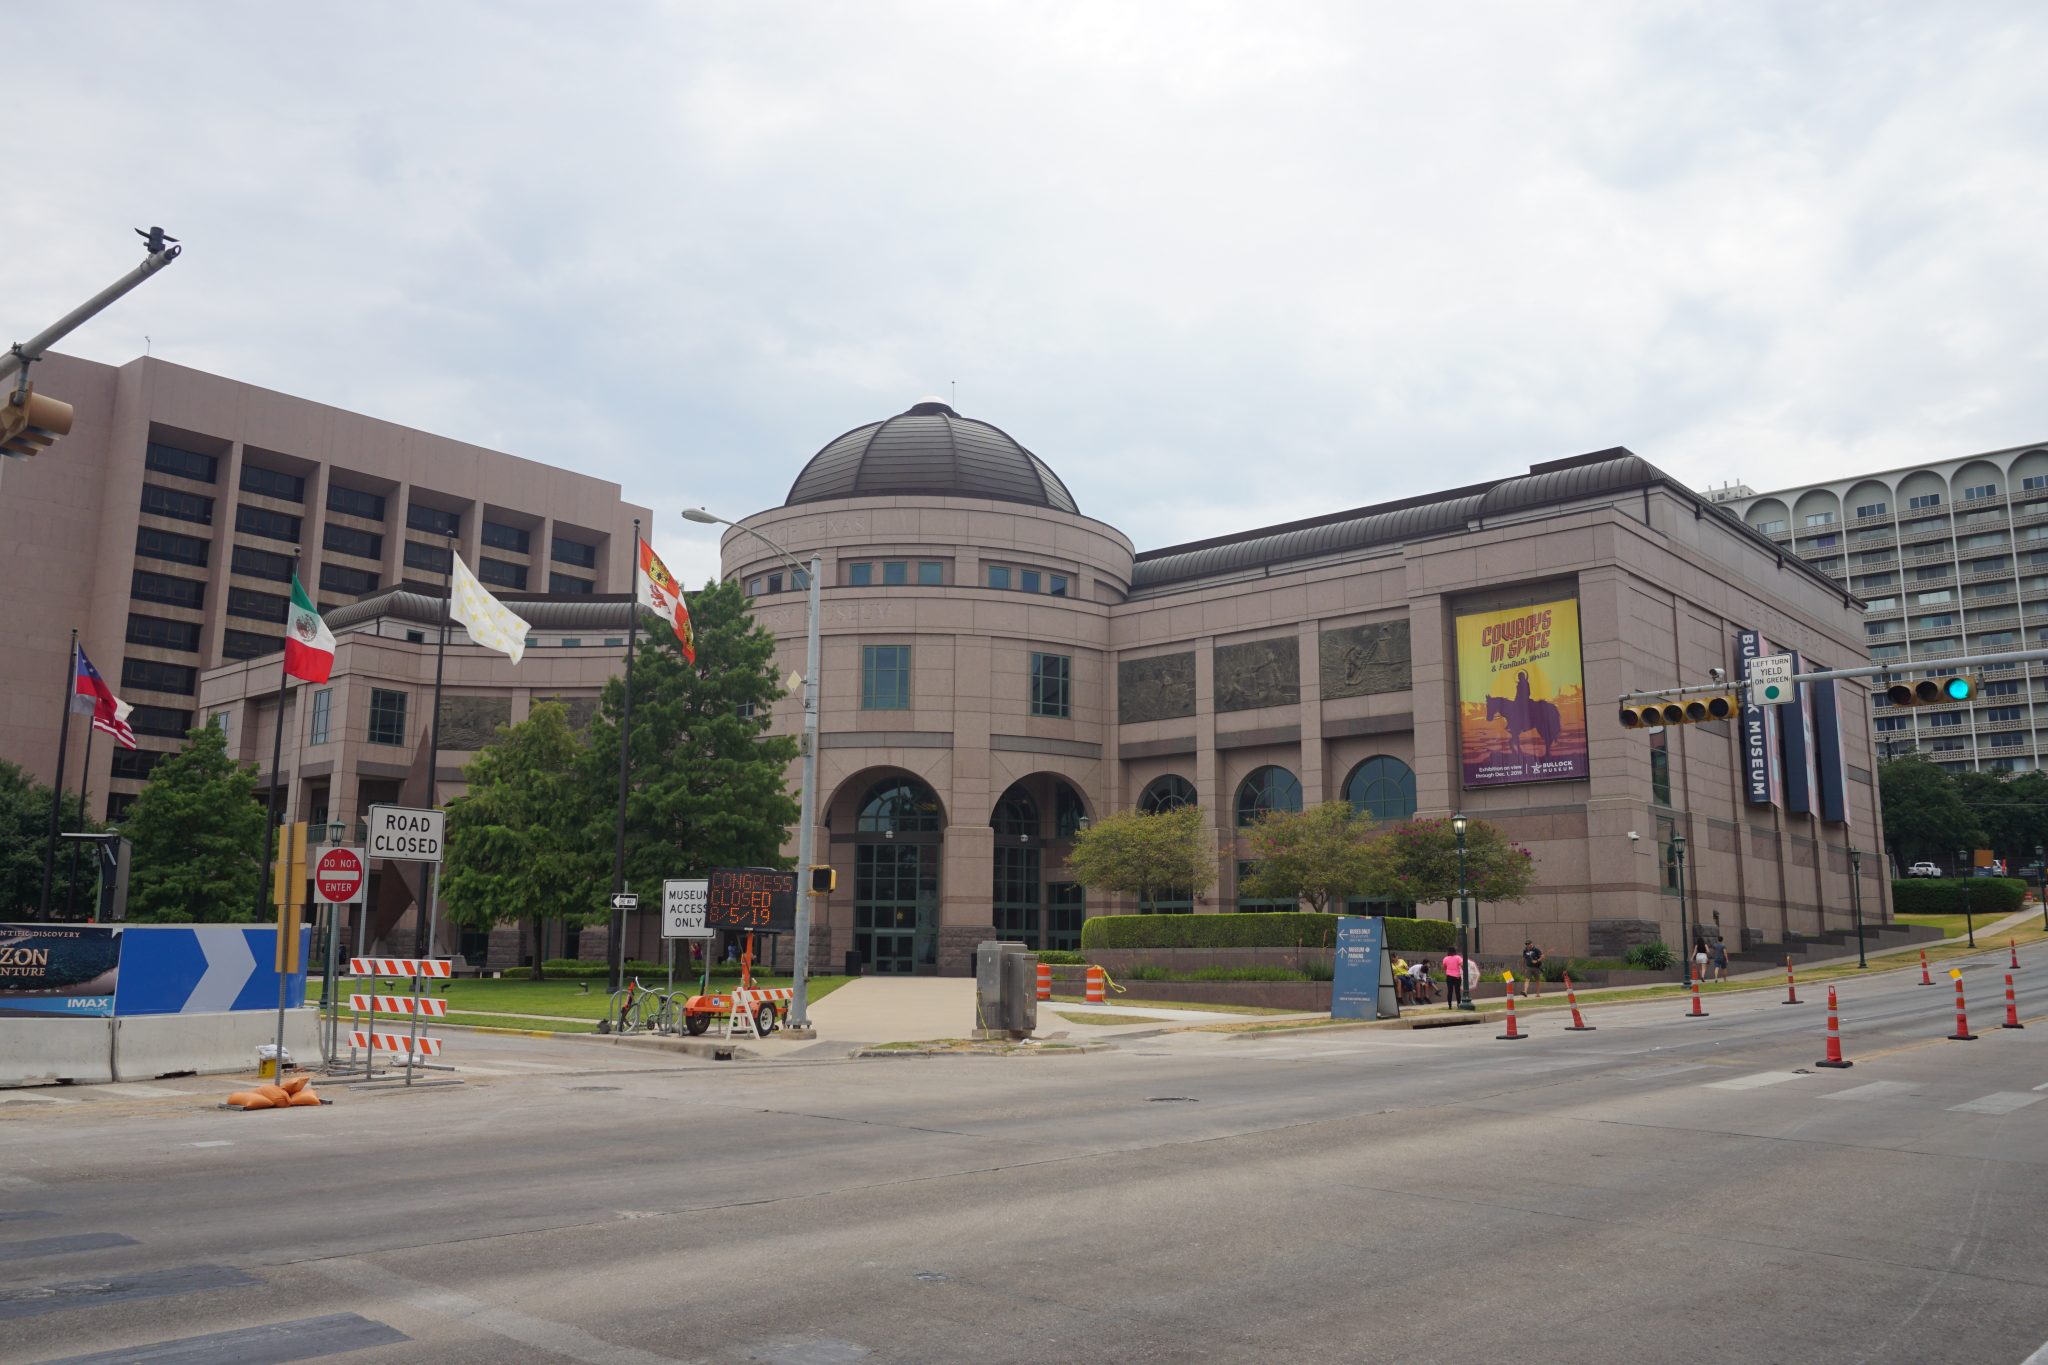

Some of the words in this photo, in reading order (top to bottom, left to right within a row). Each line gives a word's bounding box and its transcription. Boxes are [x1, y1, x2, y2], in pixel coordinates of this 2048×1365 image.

[1482, 609, 1552, 647] COWBOYS
[1490, 643, 1504, 663] IN
[1507, 630, 1551, 659] SPACE
[1752, 660, 1769, 668] LEFT
[1771, 658, 1789, 666] TURN
[1760, 667, 1782, 676] YIELD
[1742, 634, 1760, 714] BULLK
[1766, 676, 1789, 684] GREEN
[1542, 760, 1573, 768] BULLOCK
[1748, 721, 1766, 795] MUSEUM
[386, 814, 431, 833] ROAD
[375, 835, 438, 854] CLOSED
[324, 859, 335, 867] DO
[340, 859, 356, 868] NOT
[325, 882, 352, 891] ENTER
[712, 872, 793, 892] CONGRESS
[711, 889, 772, 908] CLOSED
[675, 918, 703, 928] ONLY
[709, 906, 770, 925] 8/5/19
[0, 947, 49, 966] ZON
[0, 966, 46, 976] NTURE
[67, 998, 108, 1008] IMAX
